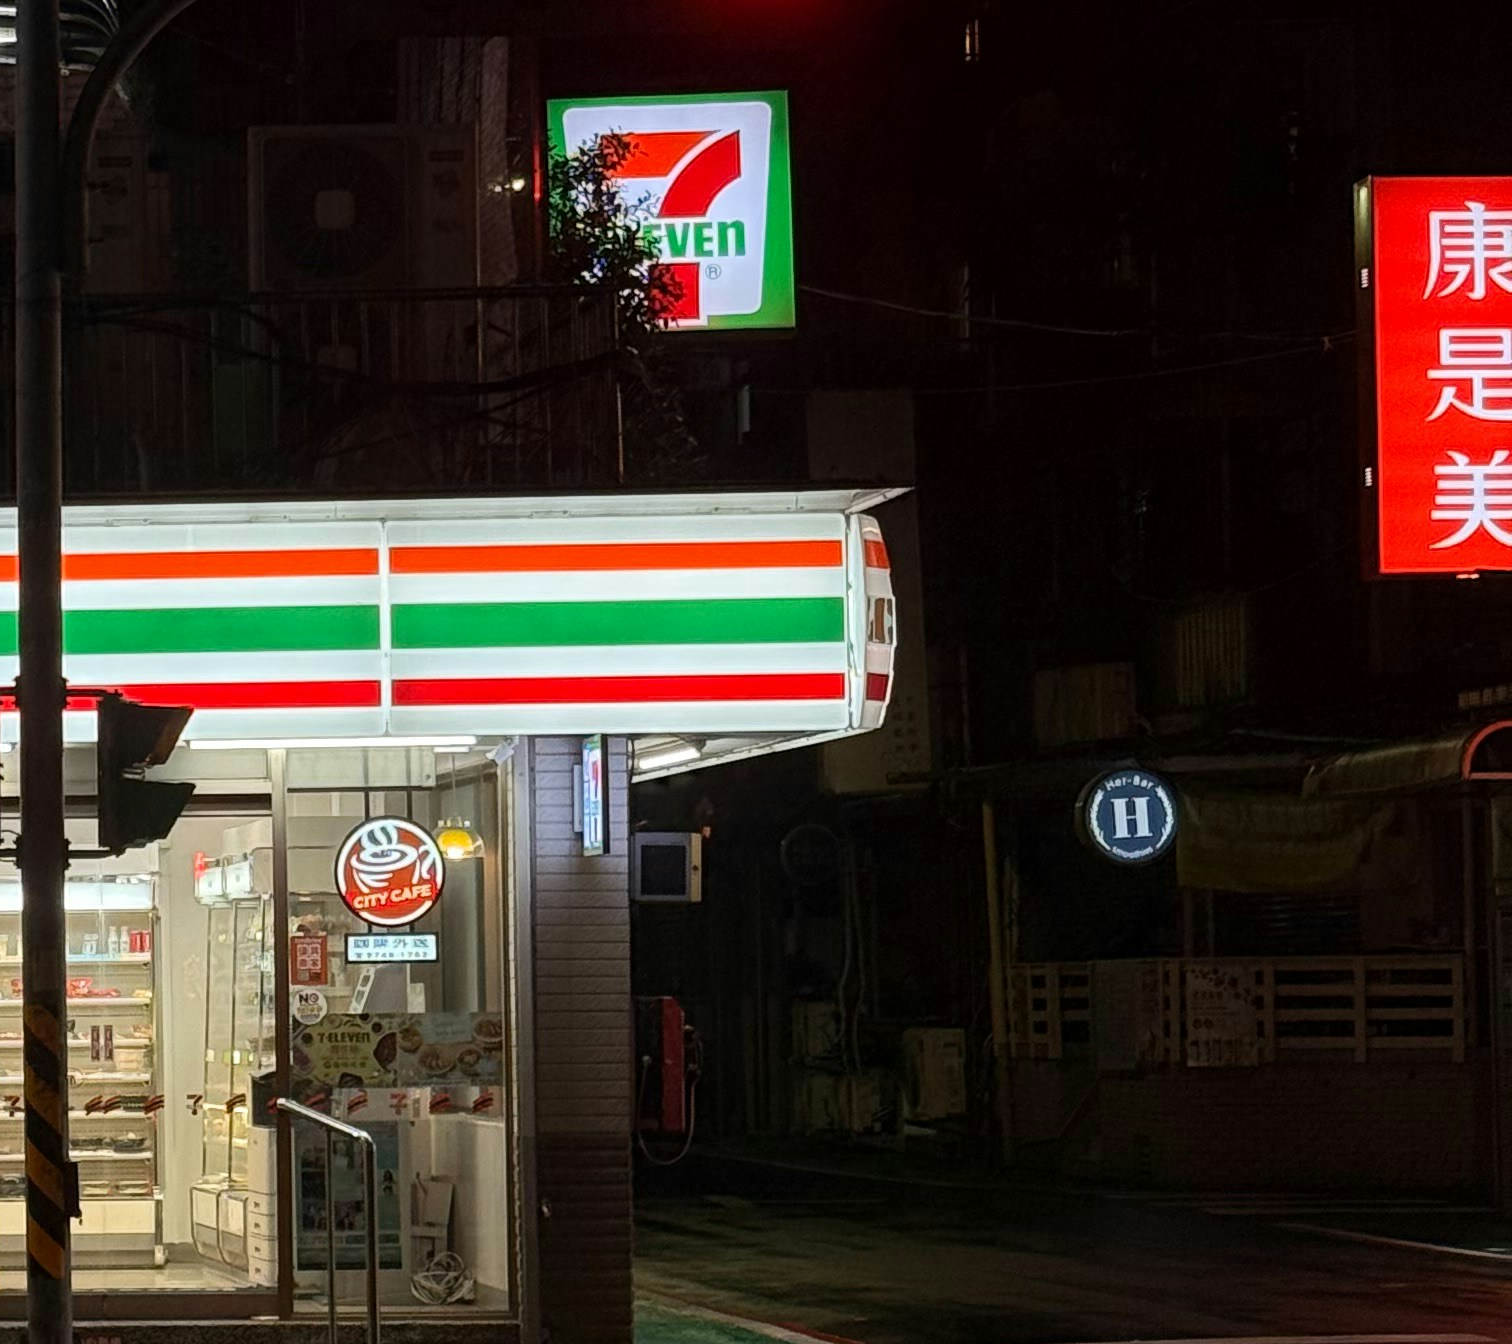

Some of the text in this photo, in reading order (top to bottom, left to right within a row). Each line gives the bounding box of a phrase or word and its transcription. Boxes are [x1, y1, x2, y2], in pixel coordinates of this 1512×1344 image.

[1423, 200, 1512, 549] 康是美
[1110, 796, 1153, 839] H
[353, 883, 433, 909] CITY CAFE
